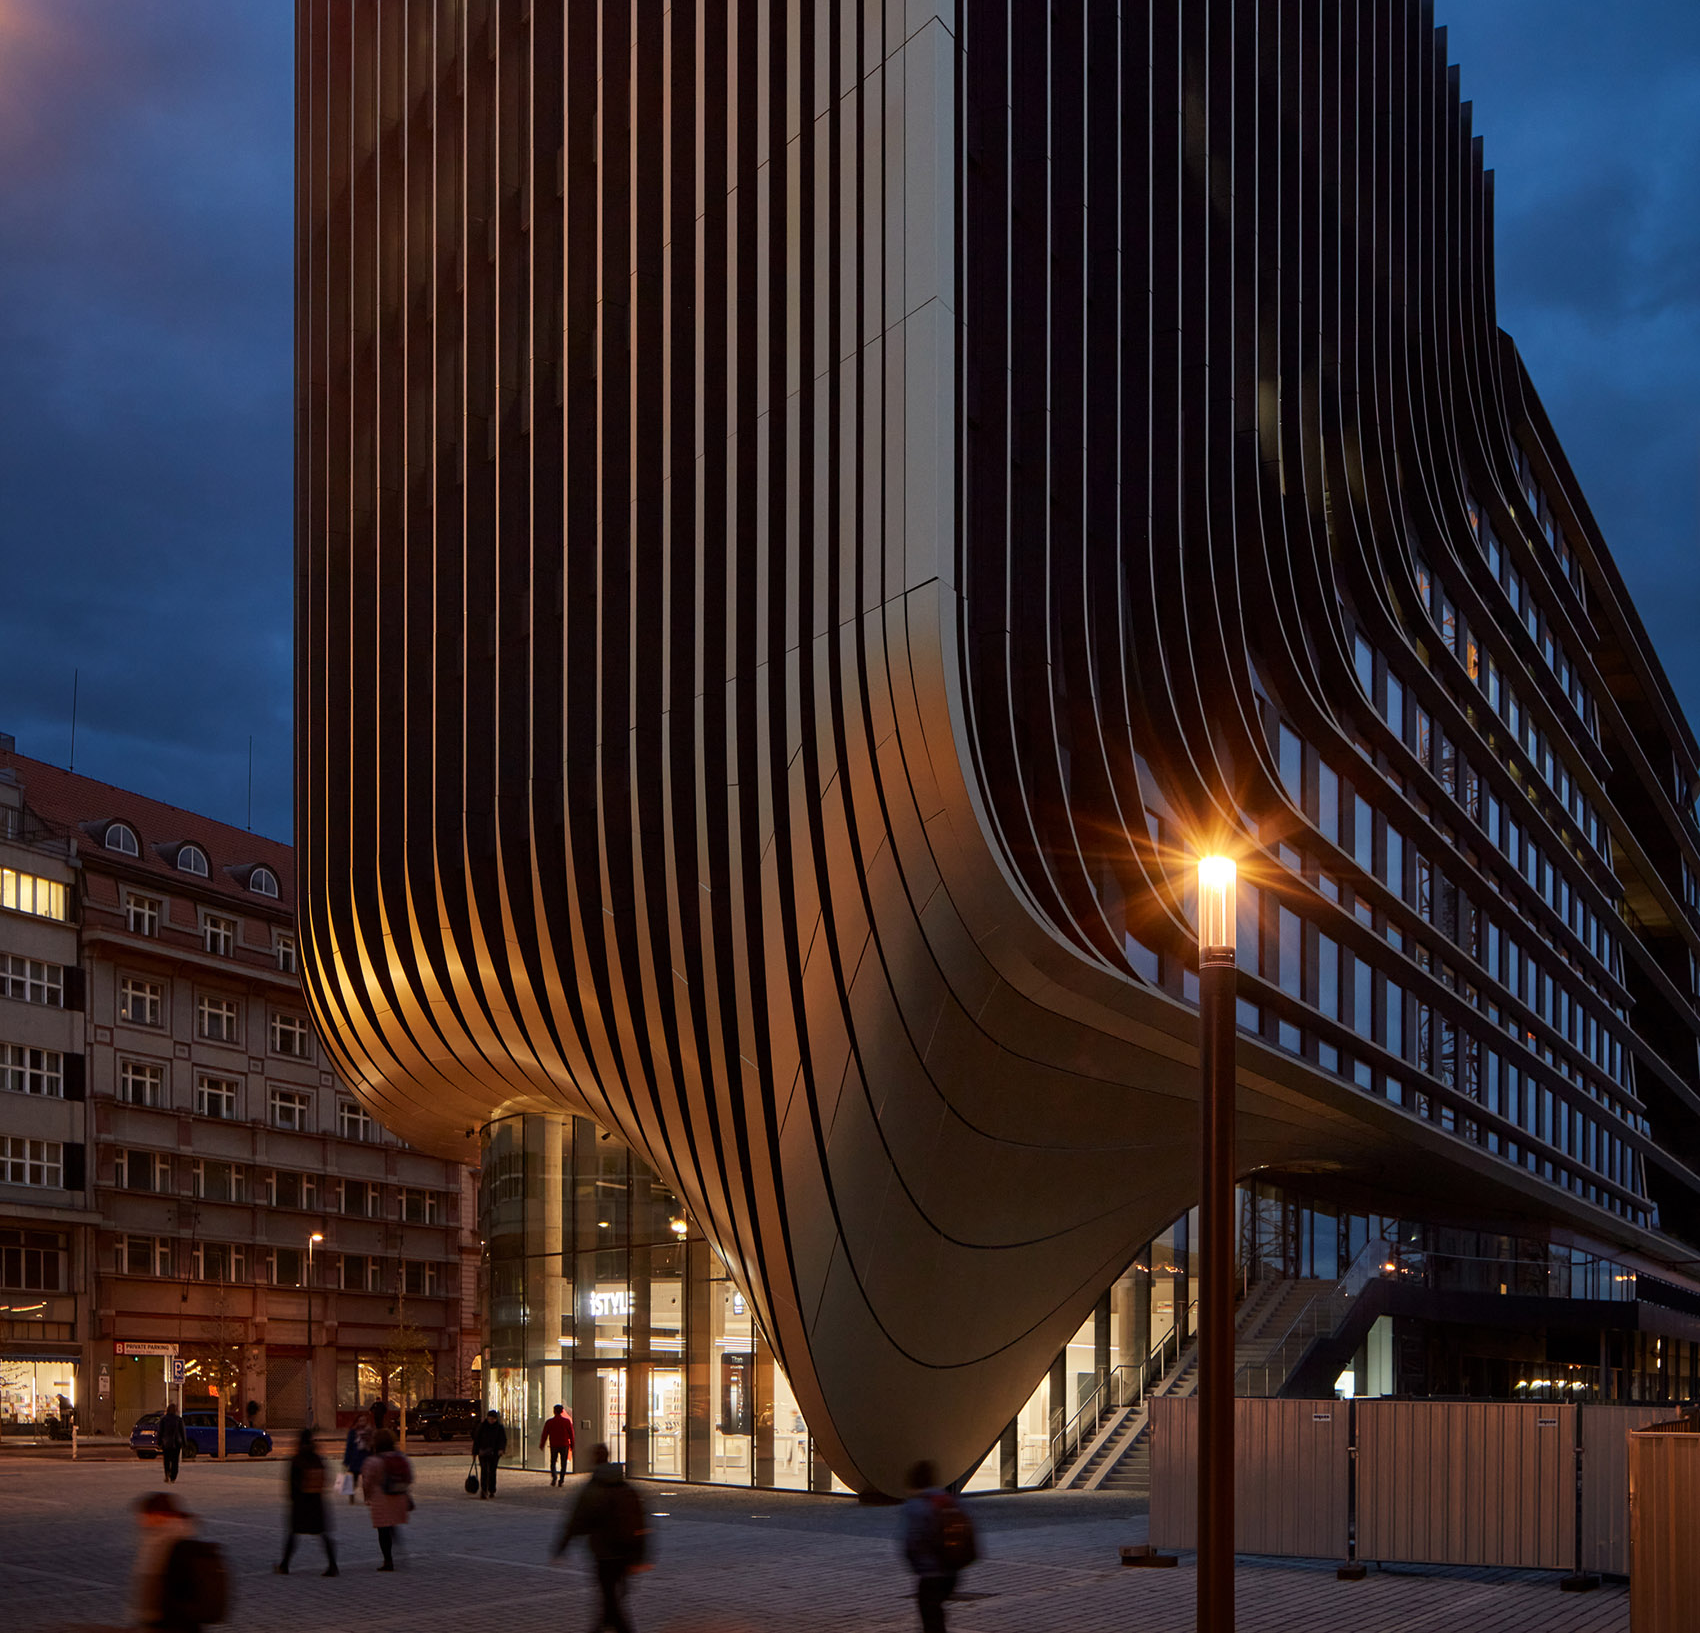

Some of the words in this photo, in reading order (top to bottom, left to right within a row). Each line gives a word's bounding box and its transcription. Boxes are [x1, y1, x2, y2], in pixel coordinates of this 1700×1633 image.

[590, 1290, 636, 1316] iSTYLE
[116, 1343, 123, 1354] B
[174, 1361, 182, 1376] P
